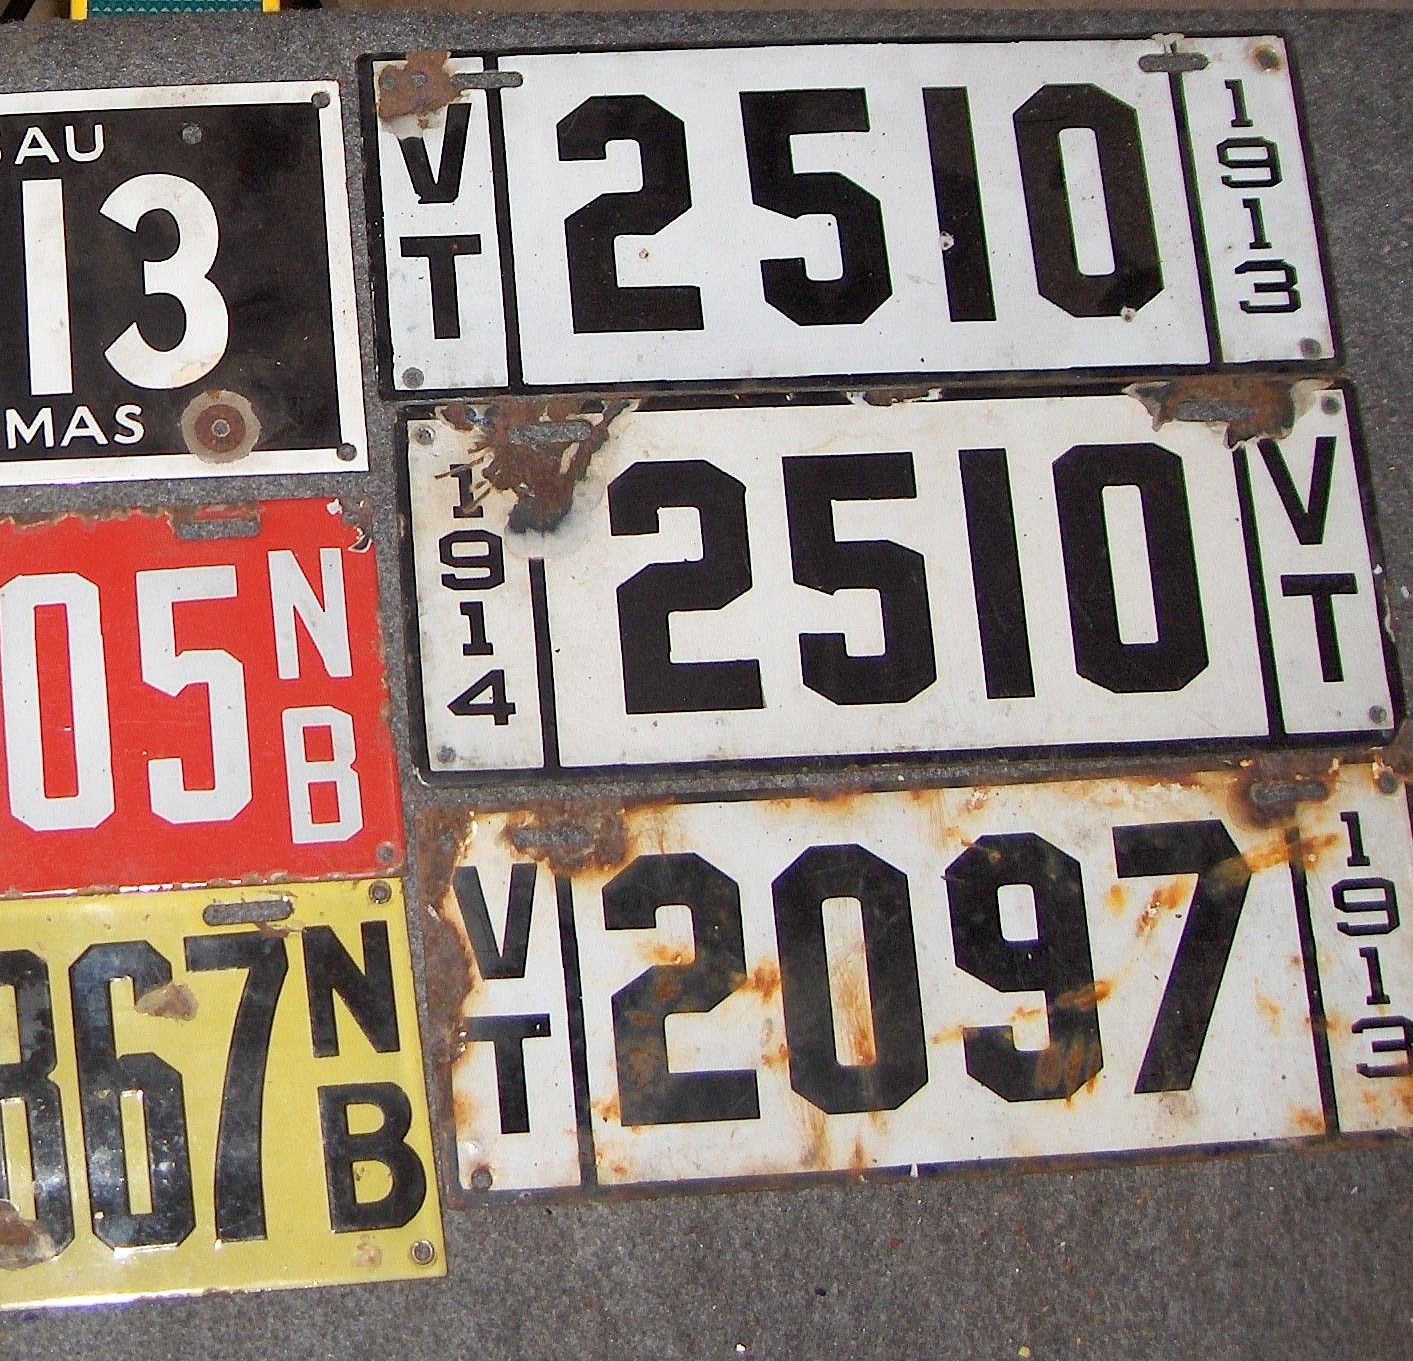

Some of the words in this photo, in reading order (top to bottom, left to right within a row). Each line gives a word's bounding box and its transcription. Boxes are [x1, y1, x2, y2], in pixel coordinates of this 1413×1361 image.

[556, 82, 1165, 335] 2510
[1216, 79, 1302, 315] 1913
[609, 442, 1210, 715] 2510
[601, 819, 1254, 1127] 2097
[1331, 810, 1413, 1078] 1913
